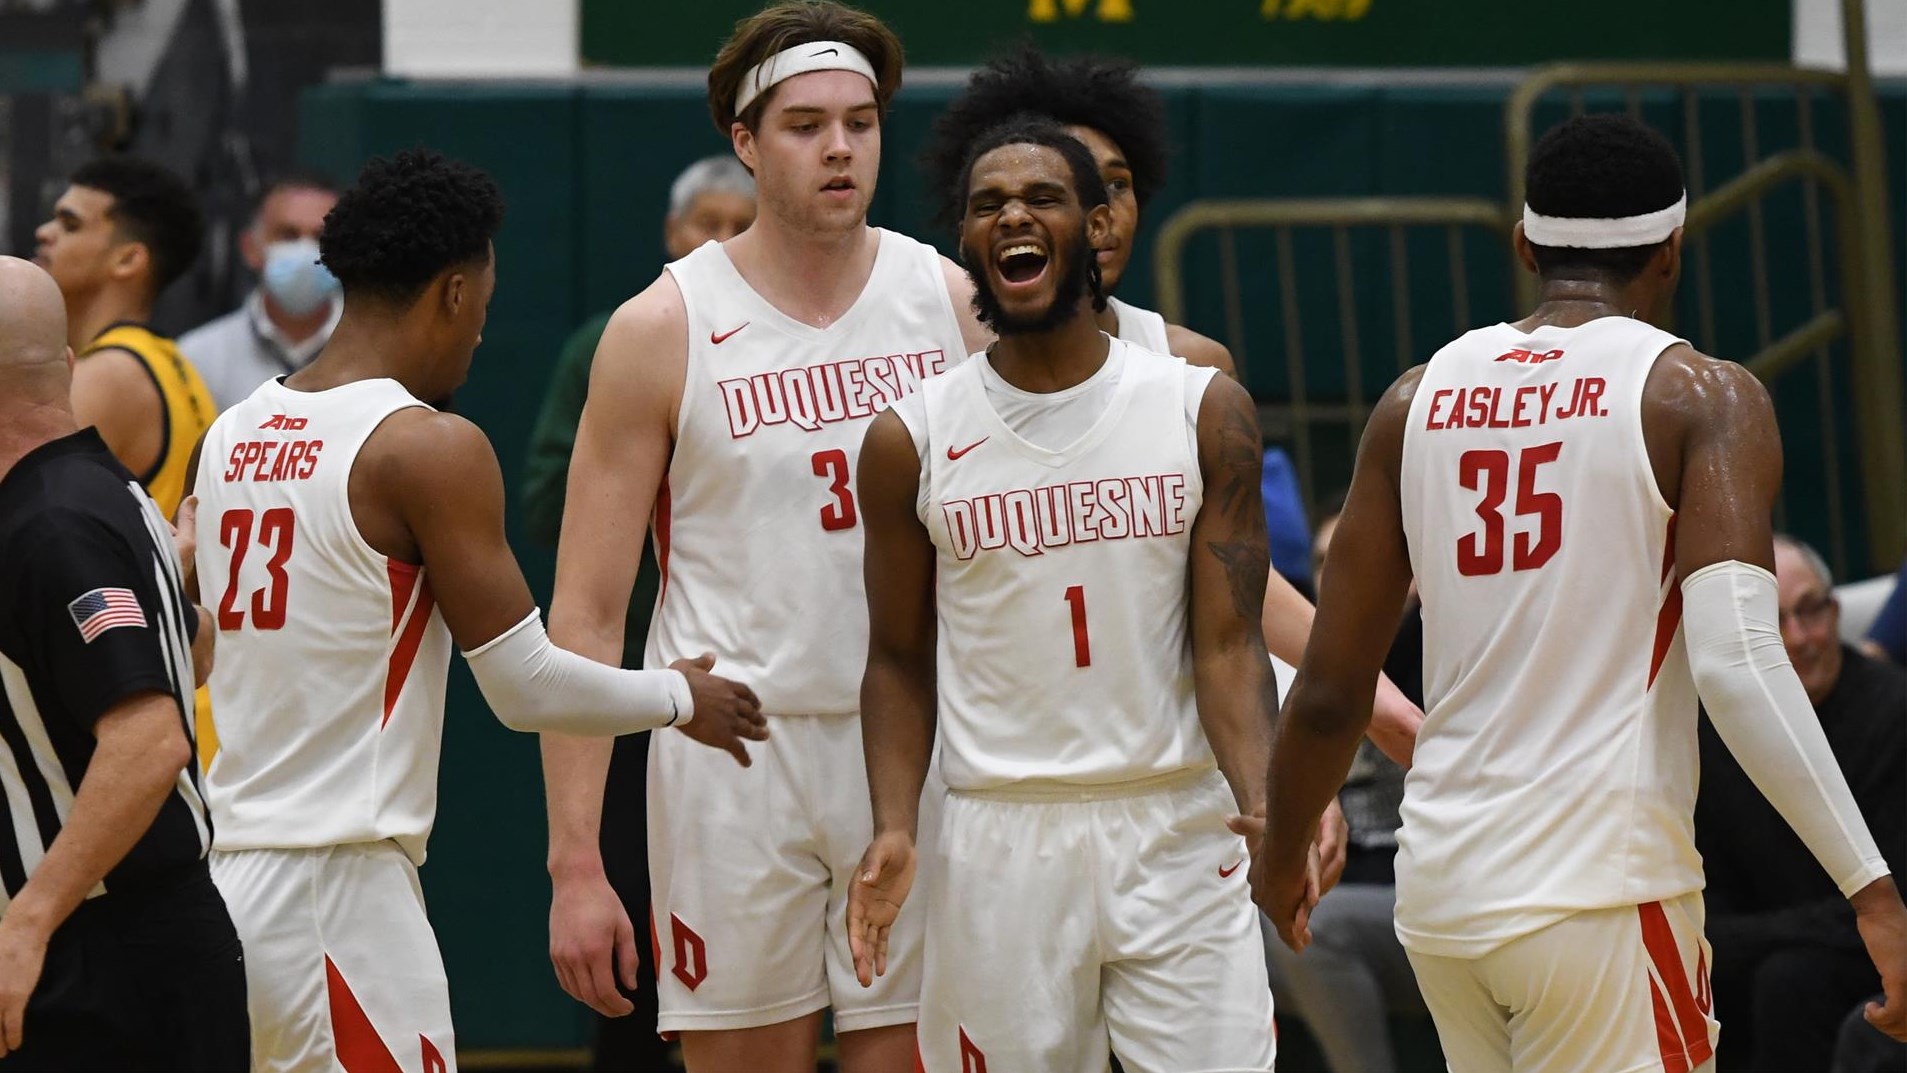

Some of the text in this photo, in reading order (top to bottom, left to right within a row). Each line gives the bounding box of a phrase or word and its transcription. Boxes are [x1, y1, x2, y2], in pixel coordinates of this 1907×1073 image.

[1426, 377, 1608, 431] EASLEY JR.
[224, 440, 323, 483] SPEARS
[811, 448, 857, 531] 3
[942, 474, 1185, 560] DUQUESNE
[1457, 441, 1563, 577] 35
[218, 507, 295, 631] 23
[1064, 585, 1090, 668] 1
